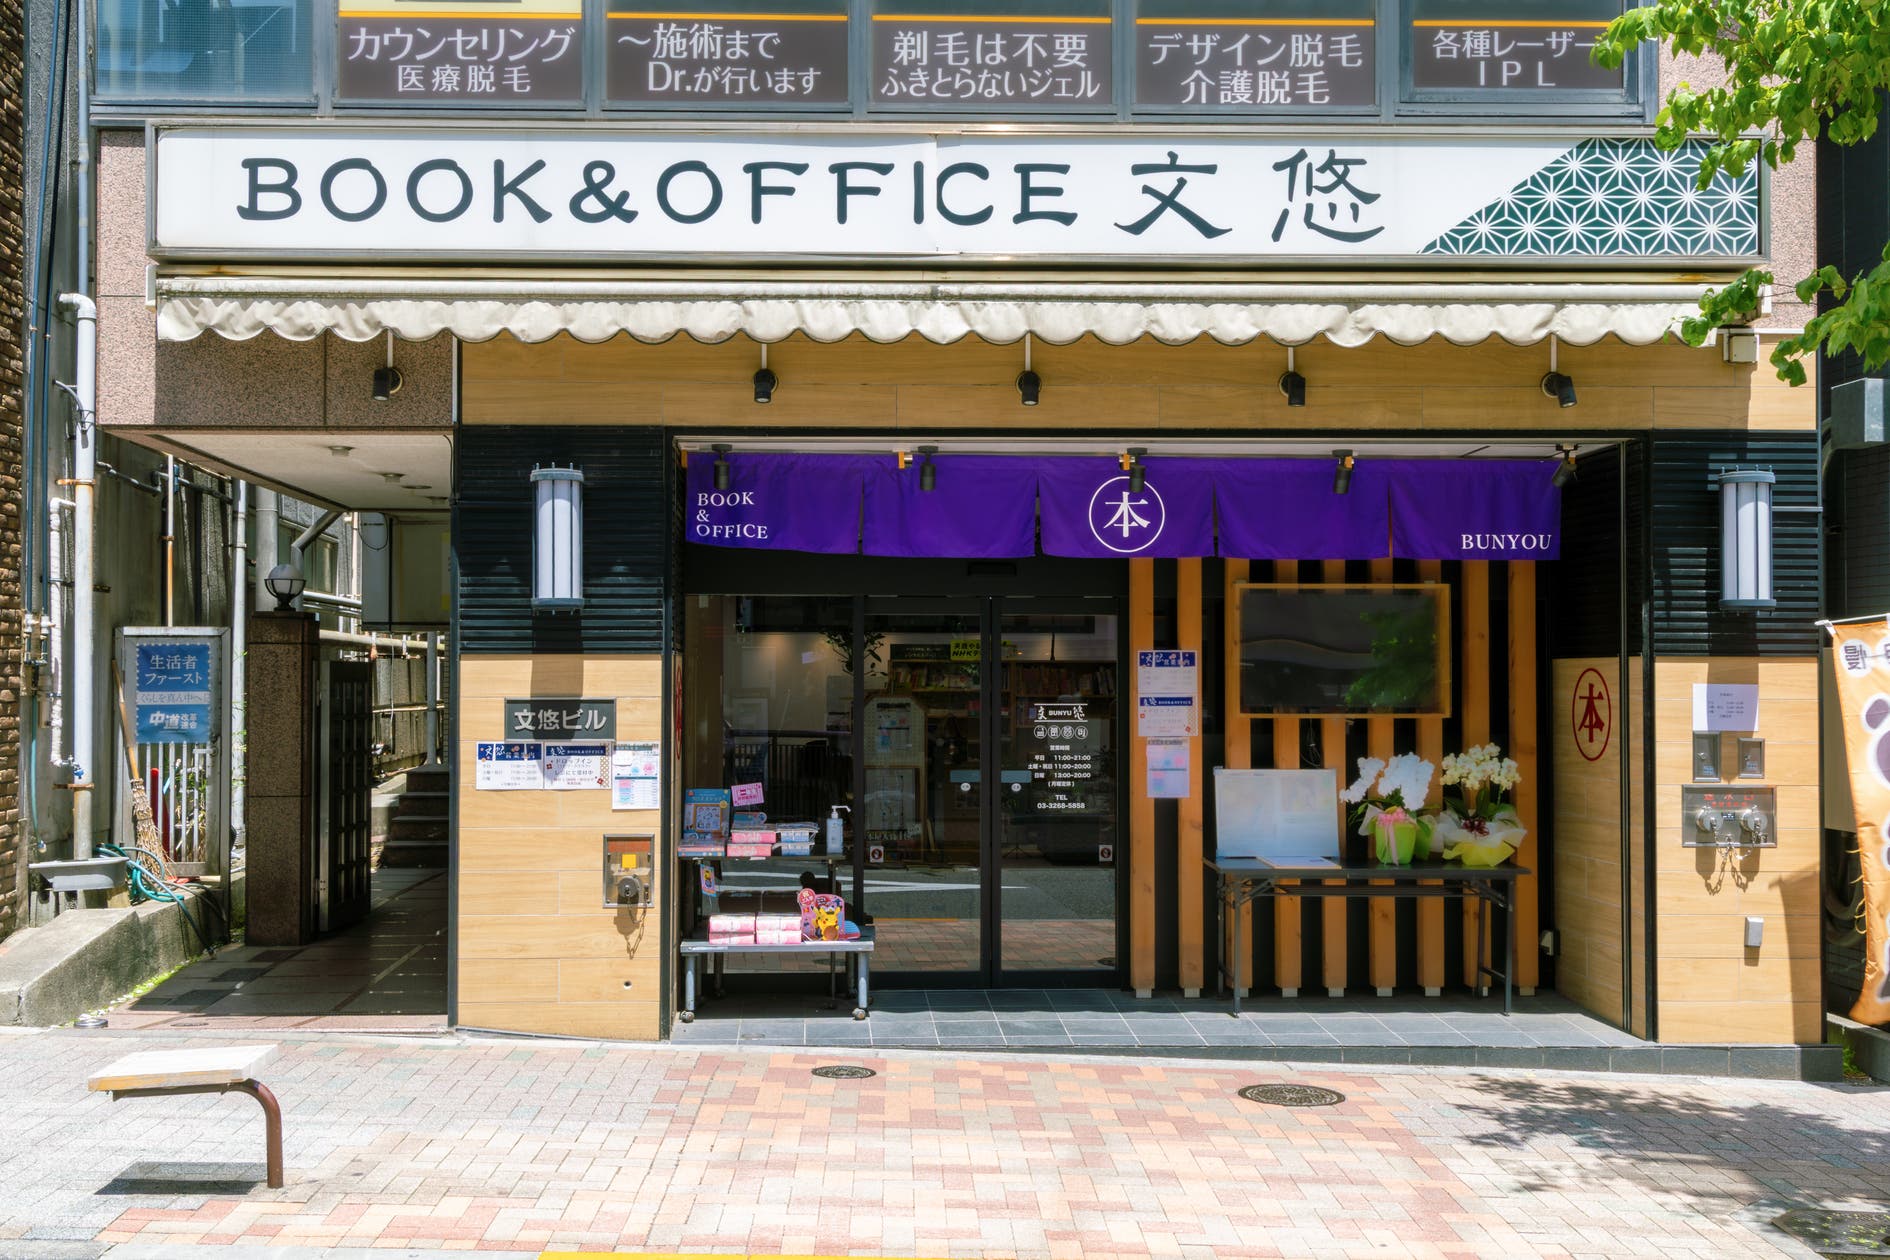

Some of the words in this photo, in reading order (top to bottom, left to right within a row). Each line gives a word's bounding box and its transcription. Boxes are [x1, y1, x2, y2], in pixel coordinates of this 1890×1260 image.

[347, 26, 577, 63] カウンセリング
[892, 29, 1089, 68] 剃毛は不要
[1148, 33, 1364, 69] デザイン脱毛
[1431, 28, 1600, 60] 各種レーザー
[397, 64, 531, 93] 医療脱毛
[647, 61, 822, 95] Dr.が行います
[879, 68, 1101, 100] ふきとらないジェル
[1179, 69, 1331, 105] 介護脱毛
[235, 155, 1080, 226] BOOK&OFFICE
[1113, 147, 1386, 243] 文悠
[696, 490, 755, 507] BOOK
[1102, 490, 1151, 538] 本
[695, 508, 710, 522] &
[695, 523, 769, 539] OFFICE
[1460, 533, 1553, 551] BUNYOU
[144, 671, 203, 686] ファースト
[149, 654, 198, 671] 生活者
[148, 710, 181, 730] 中道
[513, 708, 608, 732] 文悠ビル
[1577, 682, 1606, 744] 本
